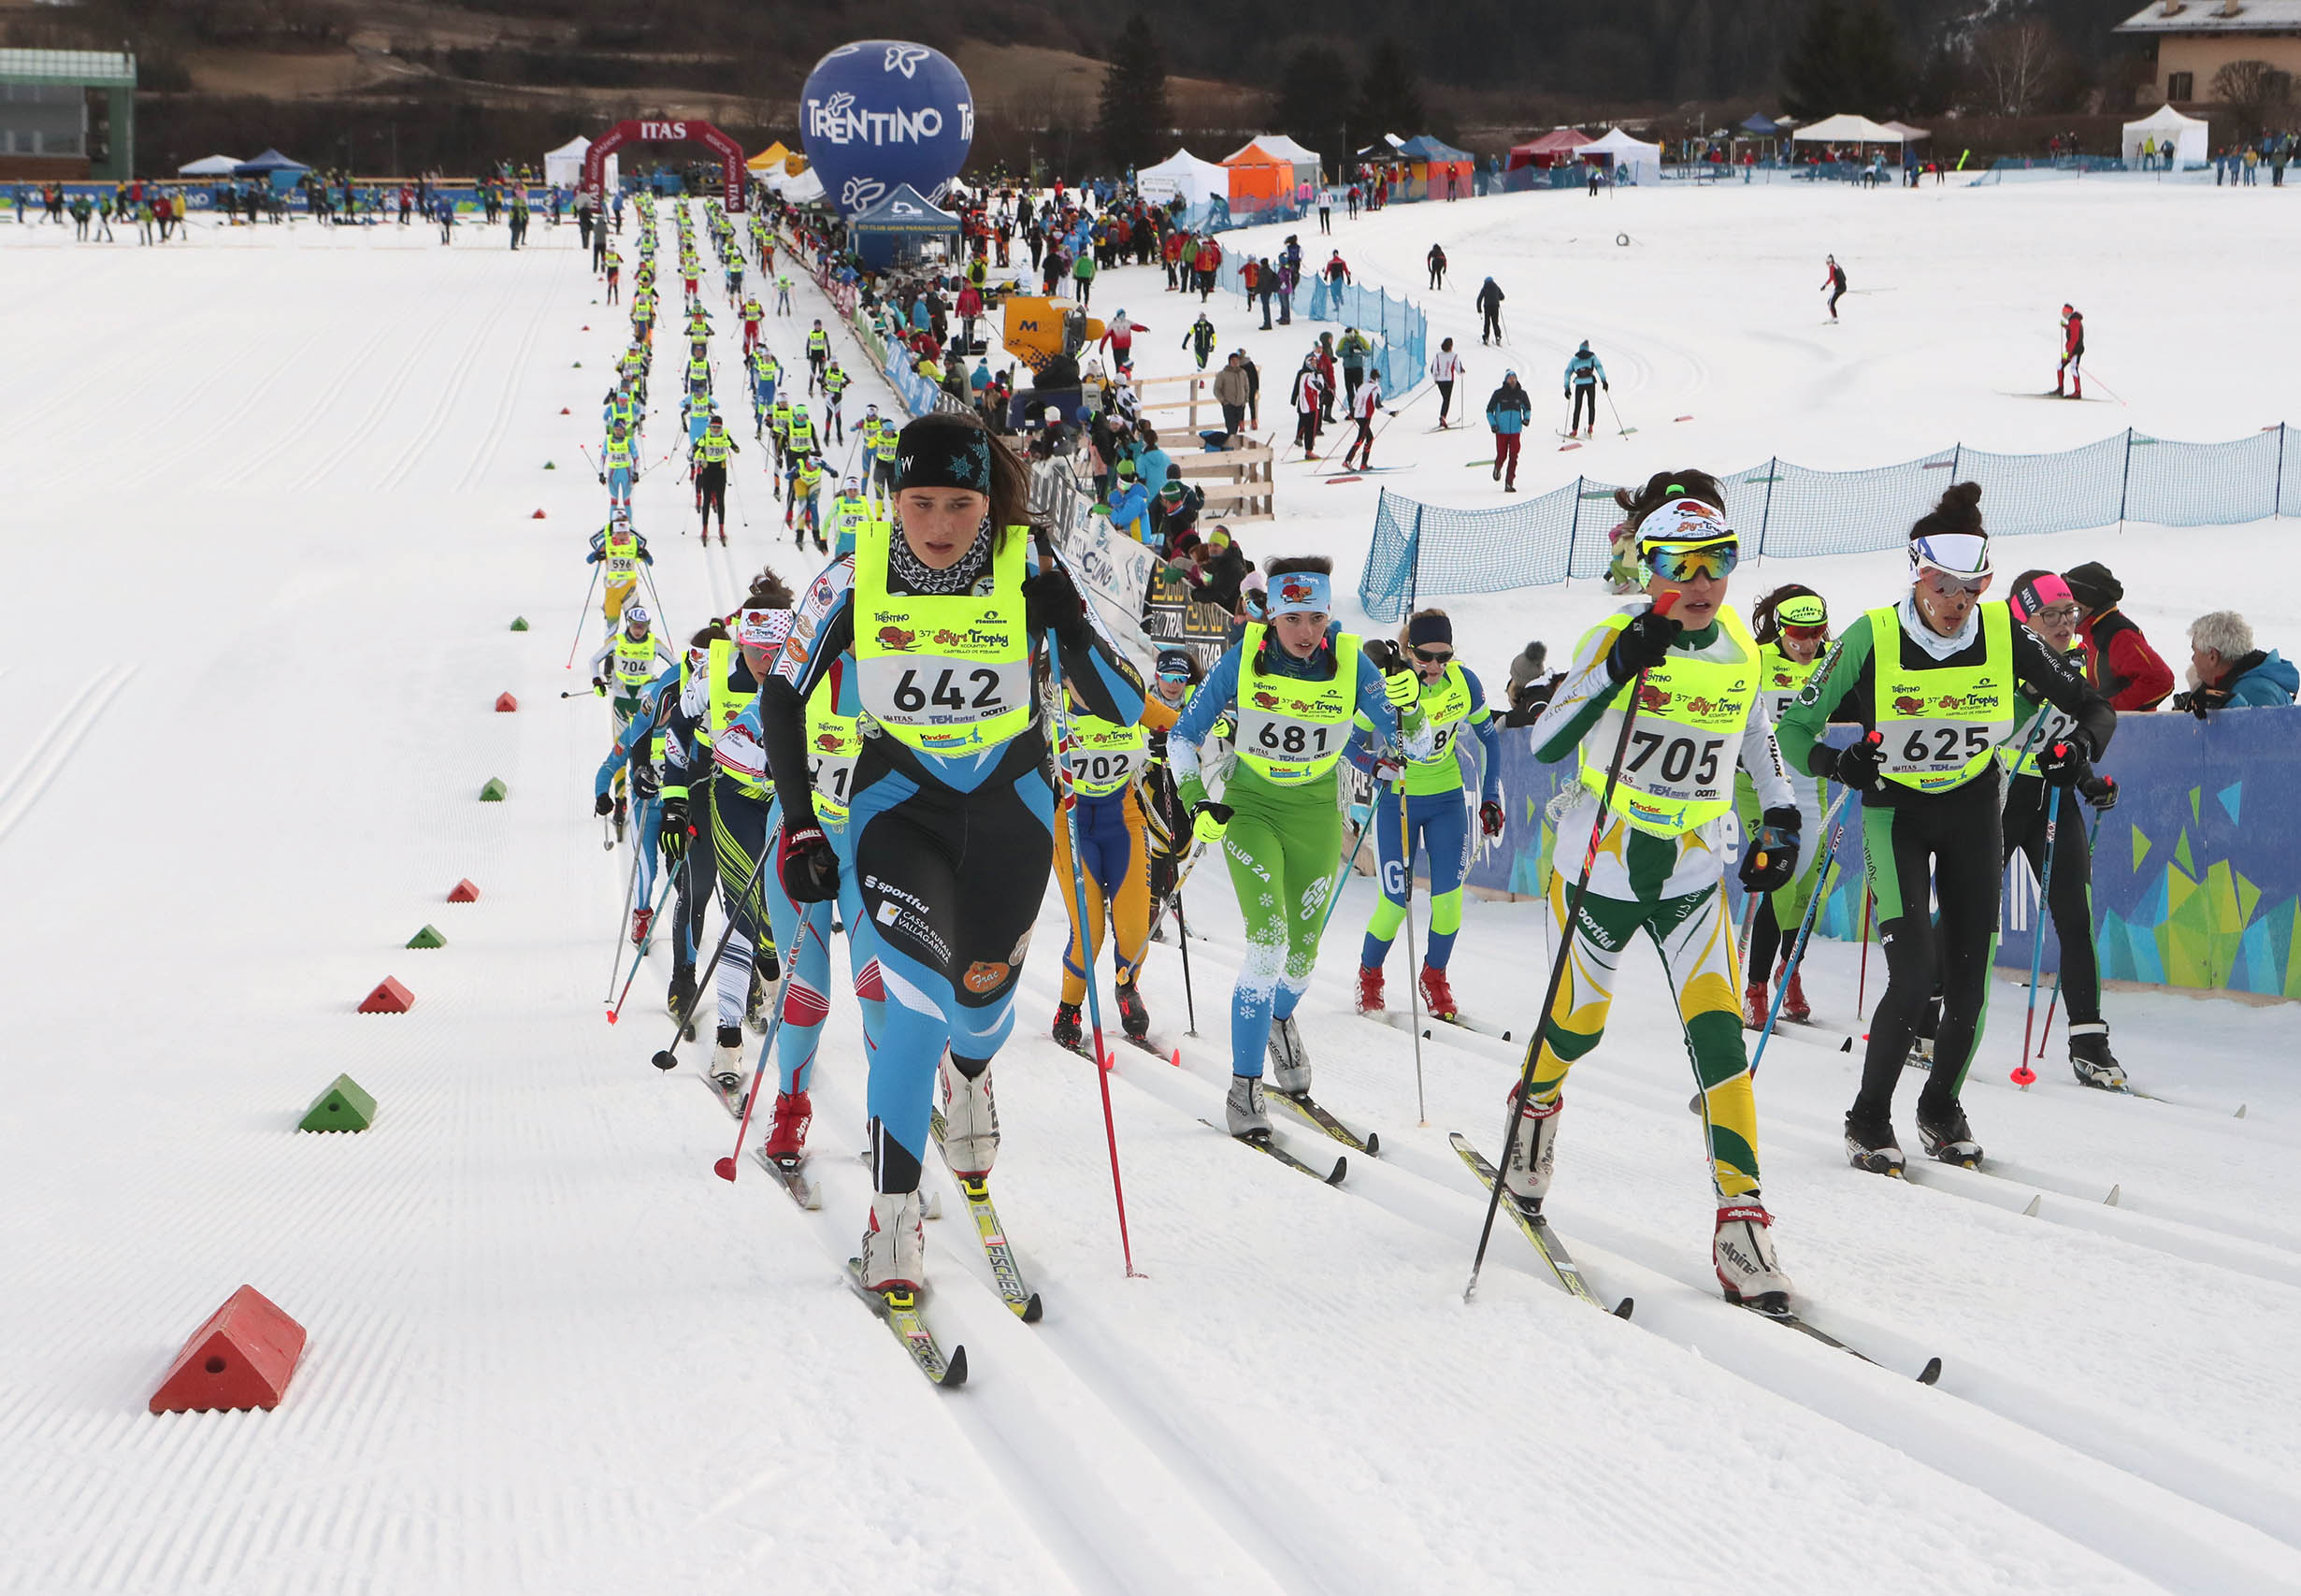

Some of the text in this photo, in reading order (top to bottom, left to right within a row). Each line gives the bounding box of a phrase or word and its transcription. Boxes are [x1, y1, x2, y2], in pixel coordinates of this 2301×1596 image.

[641, 122, 687, 139] ITAS
[808, 99, 942, 146] TRENTINO
[728, 184, 740, 209] ITAS
[612, 560, 631, 569] 596
[630, 609, 646, 617] ITA
[874, 612, 910, 623] TRENTINO
[968, 628, 1009, 647] Trophy
[622, 661, 646, 672] 704
[893, 669, 1002, 712] 642
[1253, 682, 1277, 691] TRENTINO
[1891, 684, 1920, 694] TRENTINO
[1315, 700, 1343, 714] Trophy
[1966, 693, 1999, 708] Trophy
[818, 722, 844, 731] TRENTINO
[1258, 722, 1328, 754] 681
[1903, 726, 1990, 762] 625
[1072, 755, 1129, 780] 702
[1625, 730, 1724, 785] 705
[1618, 773, 1634, 784] TAS
[1630, 799, 1661, 813] kinder
[1227, 841, 1271, 884] CLUB 2A
[877, 881, 930, 915] sportful
[903, 911, 929, 933] CASSA
[929, 929, 952, 958] RURALE
[1578, 906, 1617, 950] portful
[899, 918, 950, 964] VALLAGARINA
[1728, 1209, 1762, 1218] alpina
[1719, 1241, 1760, 1275] alpina
[985, 1244, 1021, 1301] FISCHER
